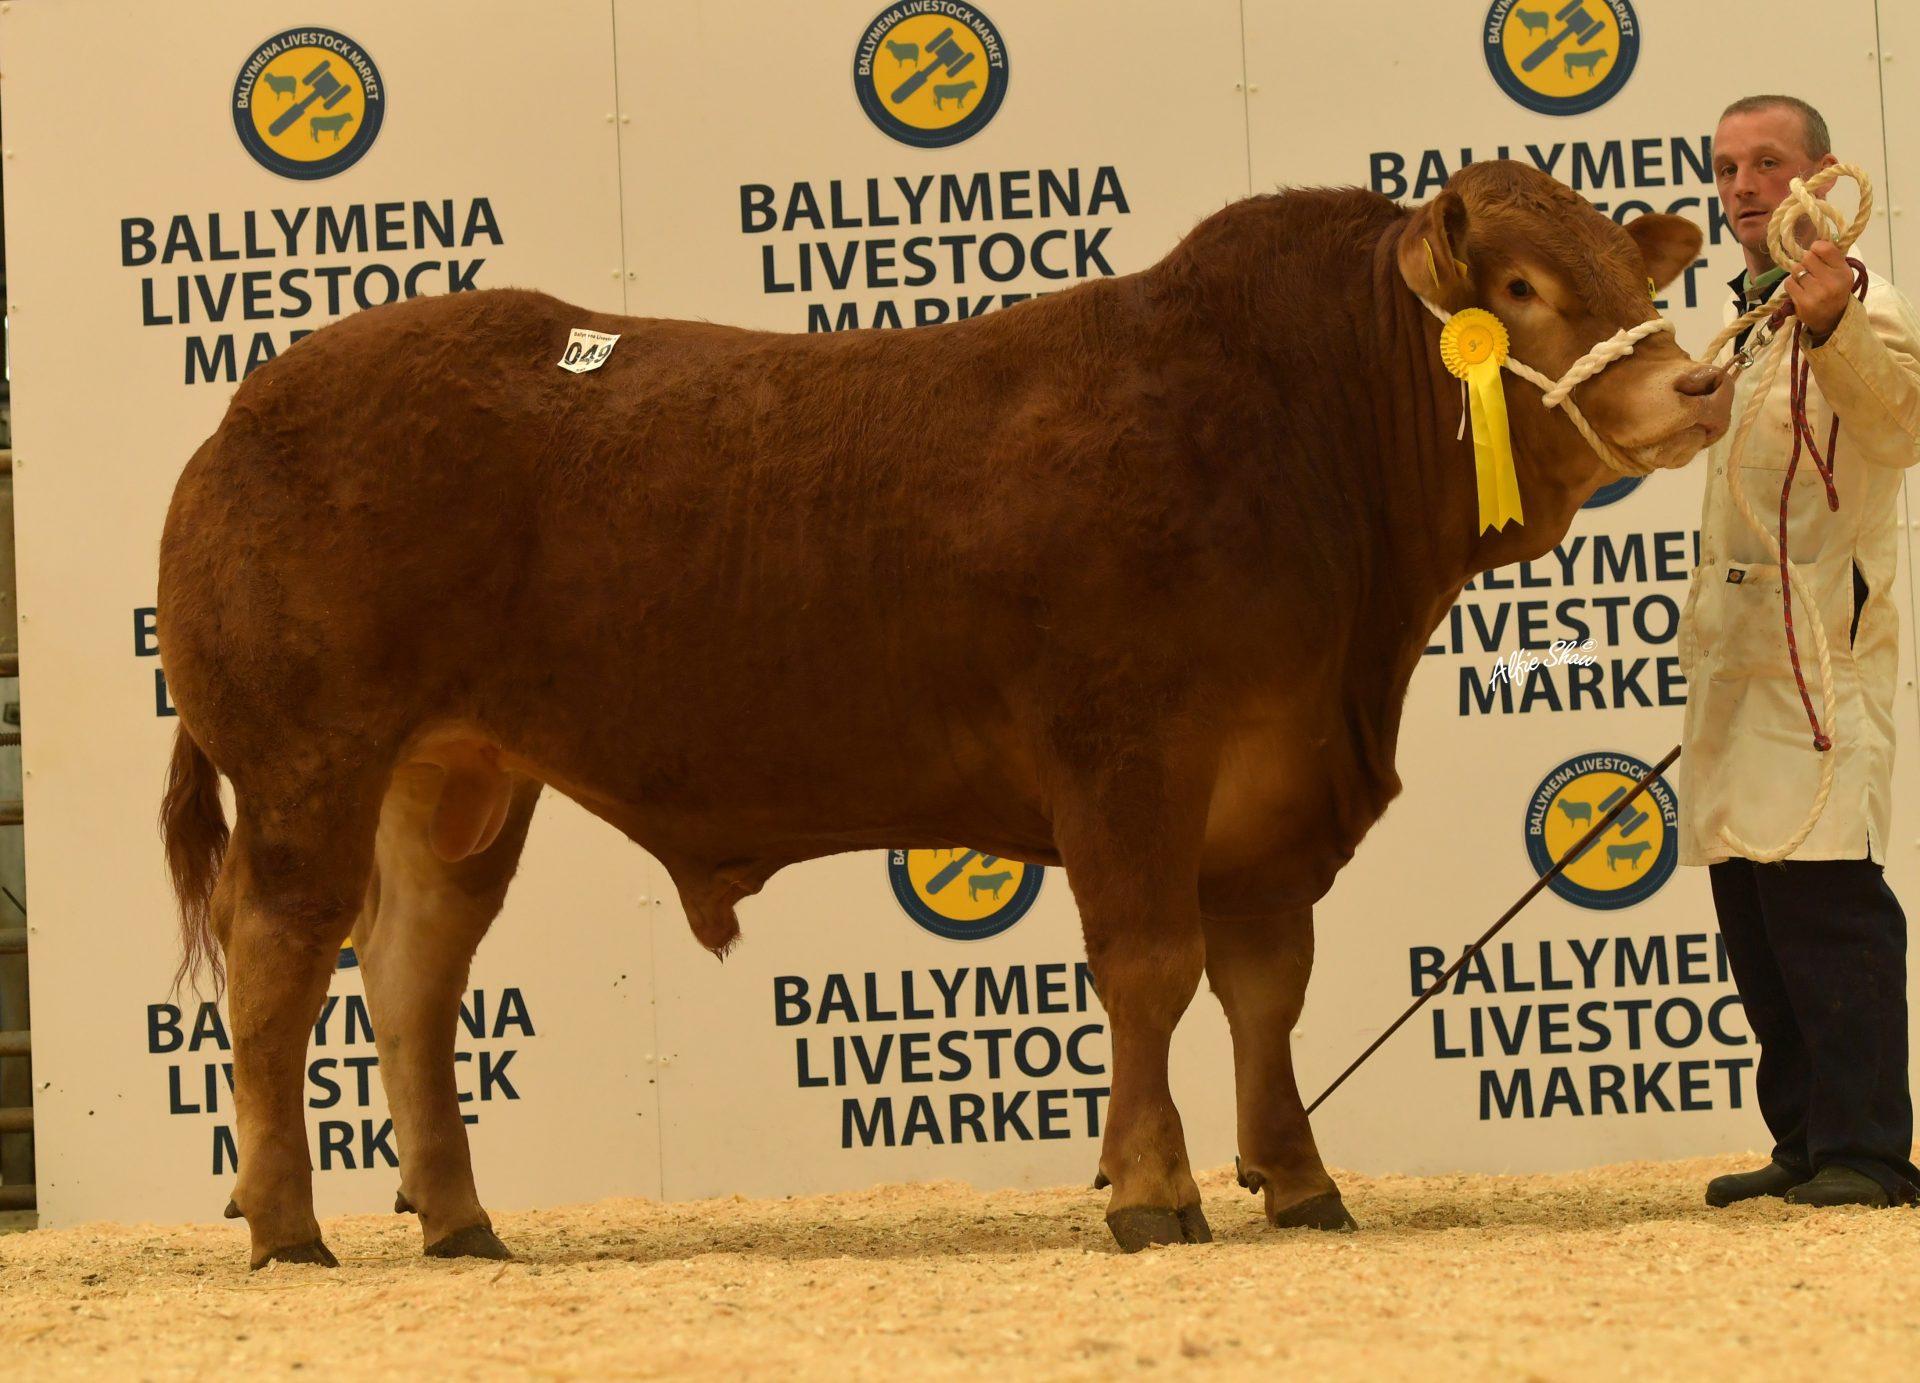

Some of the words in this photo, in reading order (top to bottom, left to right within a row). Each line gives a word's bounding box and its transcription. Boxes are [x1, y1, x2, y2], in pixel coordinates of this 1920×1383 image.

[858, 9, 903, 76] BALLYMENA
[902, 0, 975, 25] LIVESTOCK
[970, 18, 1004, 69] MARKET
[1488, 0, 1514, 44] BALLYM
[1610, 0, 1634, 37] ARKET
[237, 42, 281, 109] BALLYMENA
[280, 32, 352, 57] LIVESTOCK
[347, 51, 379, 101] MARKET
[120, 197, 504, 267] BALLYMENA
[739, 165, 1131, 234] BALLYMENA
[141, 259, 486, 326] LIVESTOCK
[762, 227, 1117, 294] LIVESTOCK
[564, 341, 611, 366] 049
[1459, 655, 1688, 717] MARKE
[1529, 767, 1576, 836] BALLYMENA
[1574, 757, 1648, 780] LIVESTOCK
[1648, 779, 1678, 829] MARKET
[796, 1024, 1106, 1088] LIVESTOC
[1432, 994, 1761, 1060] LIVESTOC
[842, 1086, 1111, 1149] MARKET
[1478, 1057, 1754, 1121] MARKET
